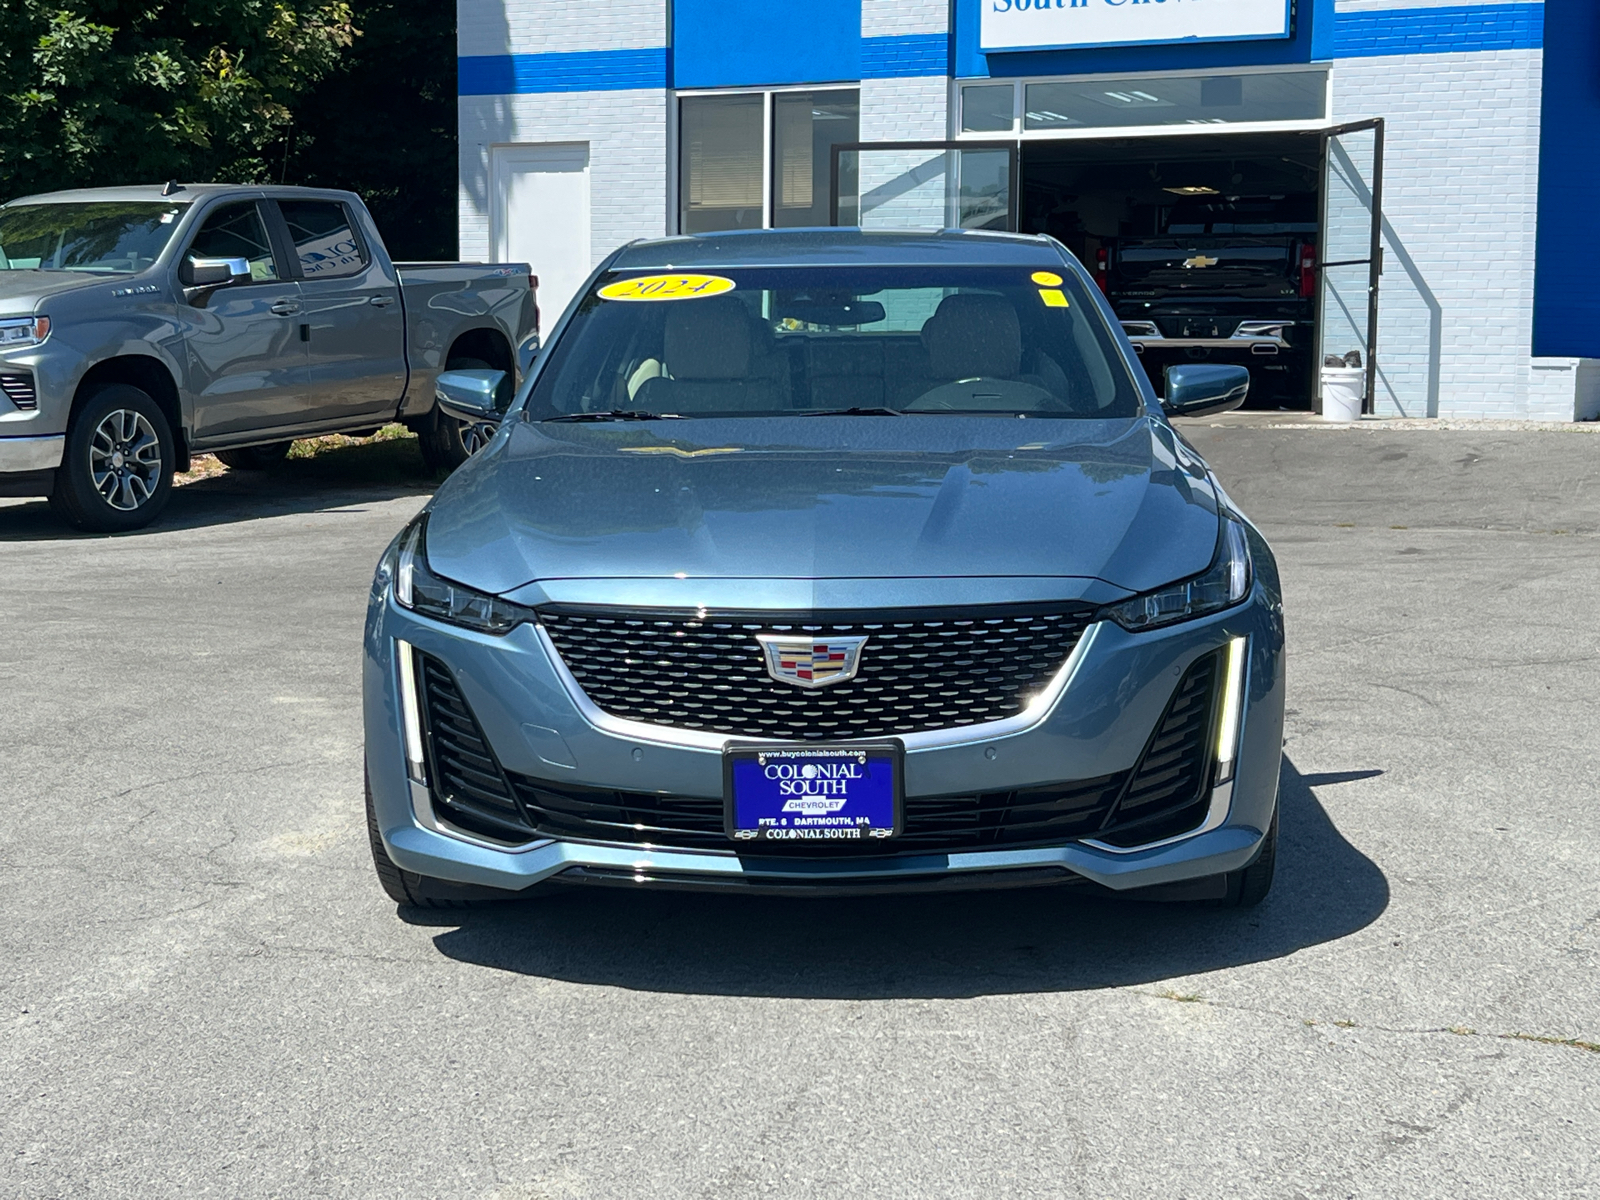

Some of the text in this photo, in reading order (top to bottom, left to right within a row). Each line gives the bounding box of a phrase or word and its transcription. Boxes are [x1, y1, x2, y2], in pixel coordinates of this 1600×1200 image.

[615, 279, 715, 297] 2024
[758, 750, 866, 758] www.buycolonialsouth.com
[764, 763, 862, 779] COLONIAL
[779, 779, 848, 795] SOUTH
[788, 801, 840, 809] CHEVROLET
[794, 817, 854, 826] DARTMOUTH,
[766, 828, 861, 839] COLONIAL SOUTH
